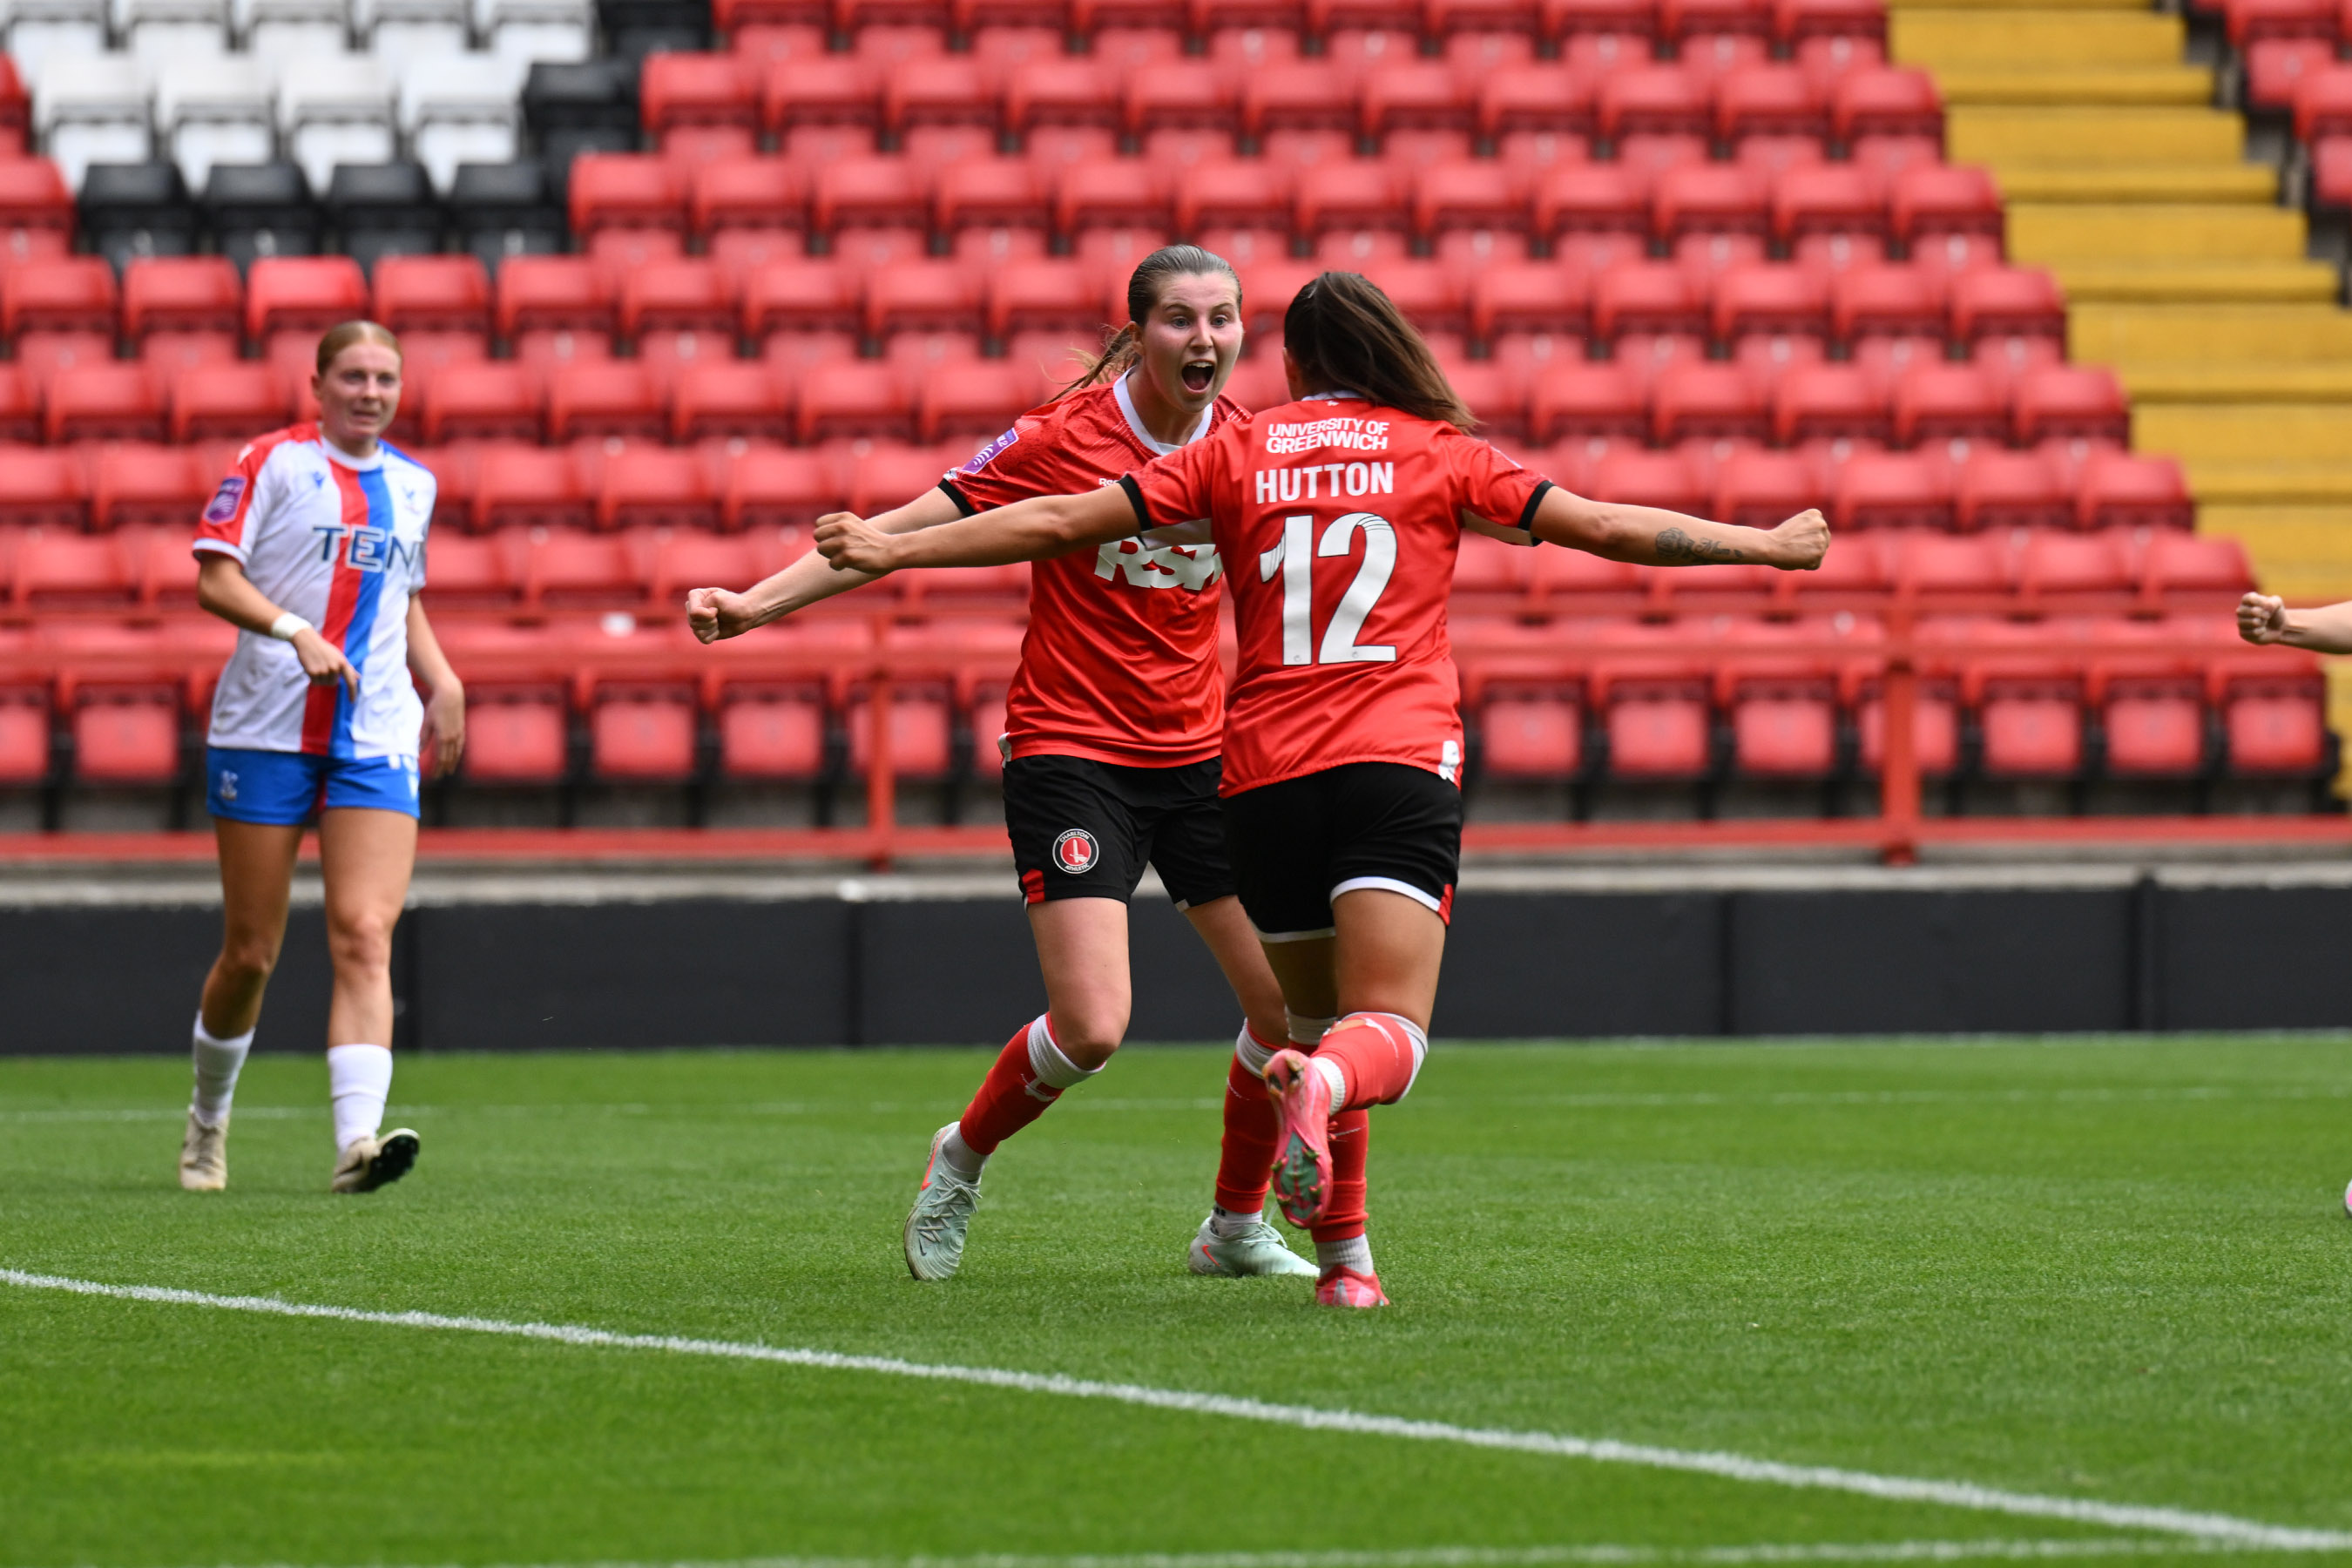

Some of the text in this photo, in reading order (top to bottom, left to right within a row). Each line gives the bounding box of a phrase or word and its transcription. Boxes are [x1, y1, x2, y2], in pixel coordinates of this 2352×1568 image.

[1267, 417, 1390, 437] UNIVERSITY OF
[1266, 430, 1389, 454] GREENWICH
[1255, 462, 1394, 504] HUTTON
[1260, 511, 1397, 666] 12
[1059, 831, 1090, 842] CHARLTON
